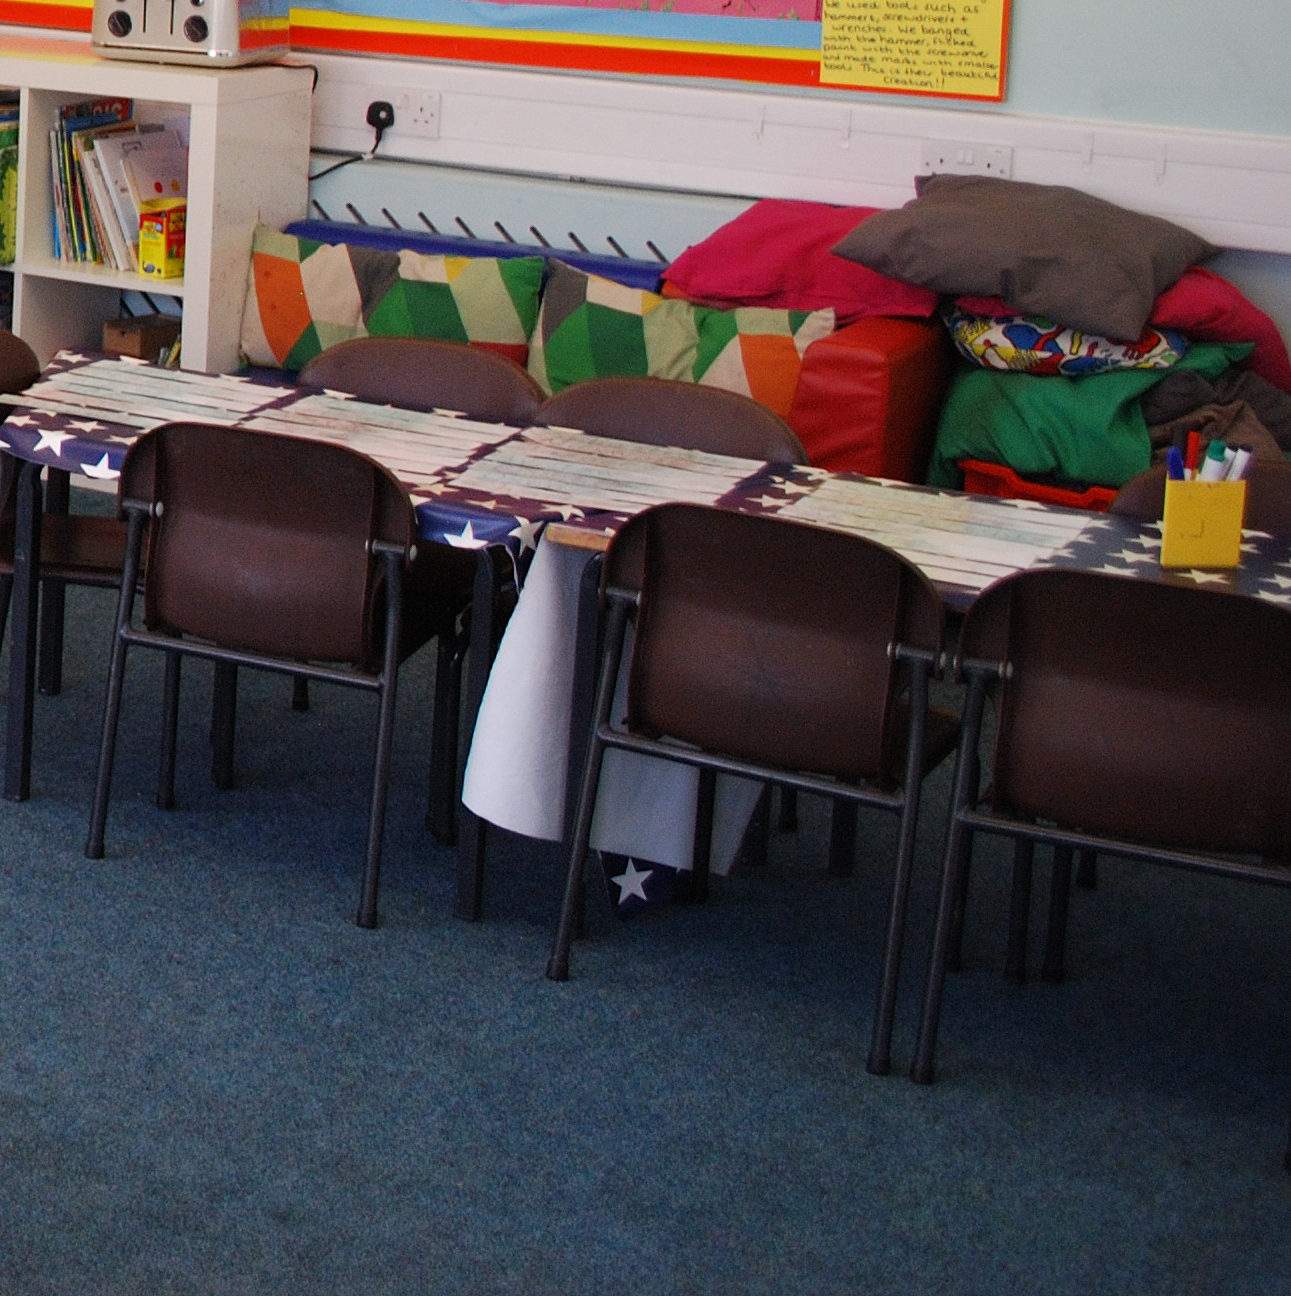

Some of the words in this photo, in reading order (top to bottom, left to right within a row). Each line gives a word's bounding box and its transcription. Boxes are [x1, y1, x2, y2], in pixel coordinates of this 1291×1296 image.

[846, 0, 879, 10] used
[924, 2, 956, 14] such
[963, 4, 979, 14] as
